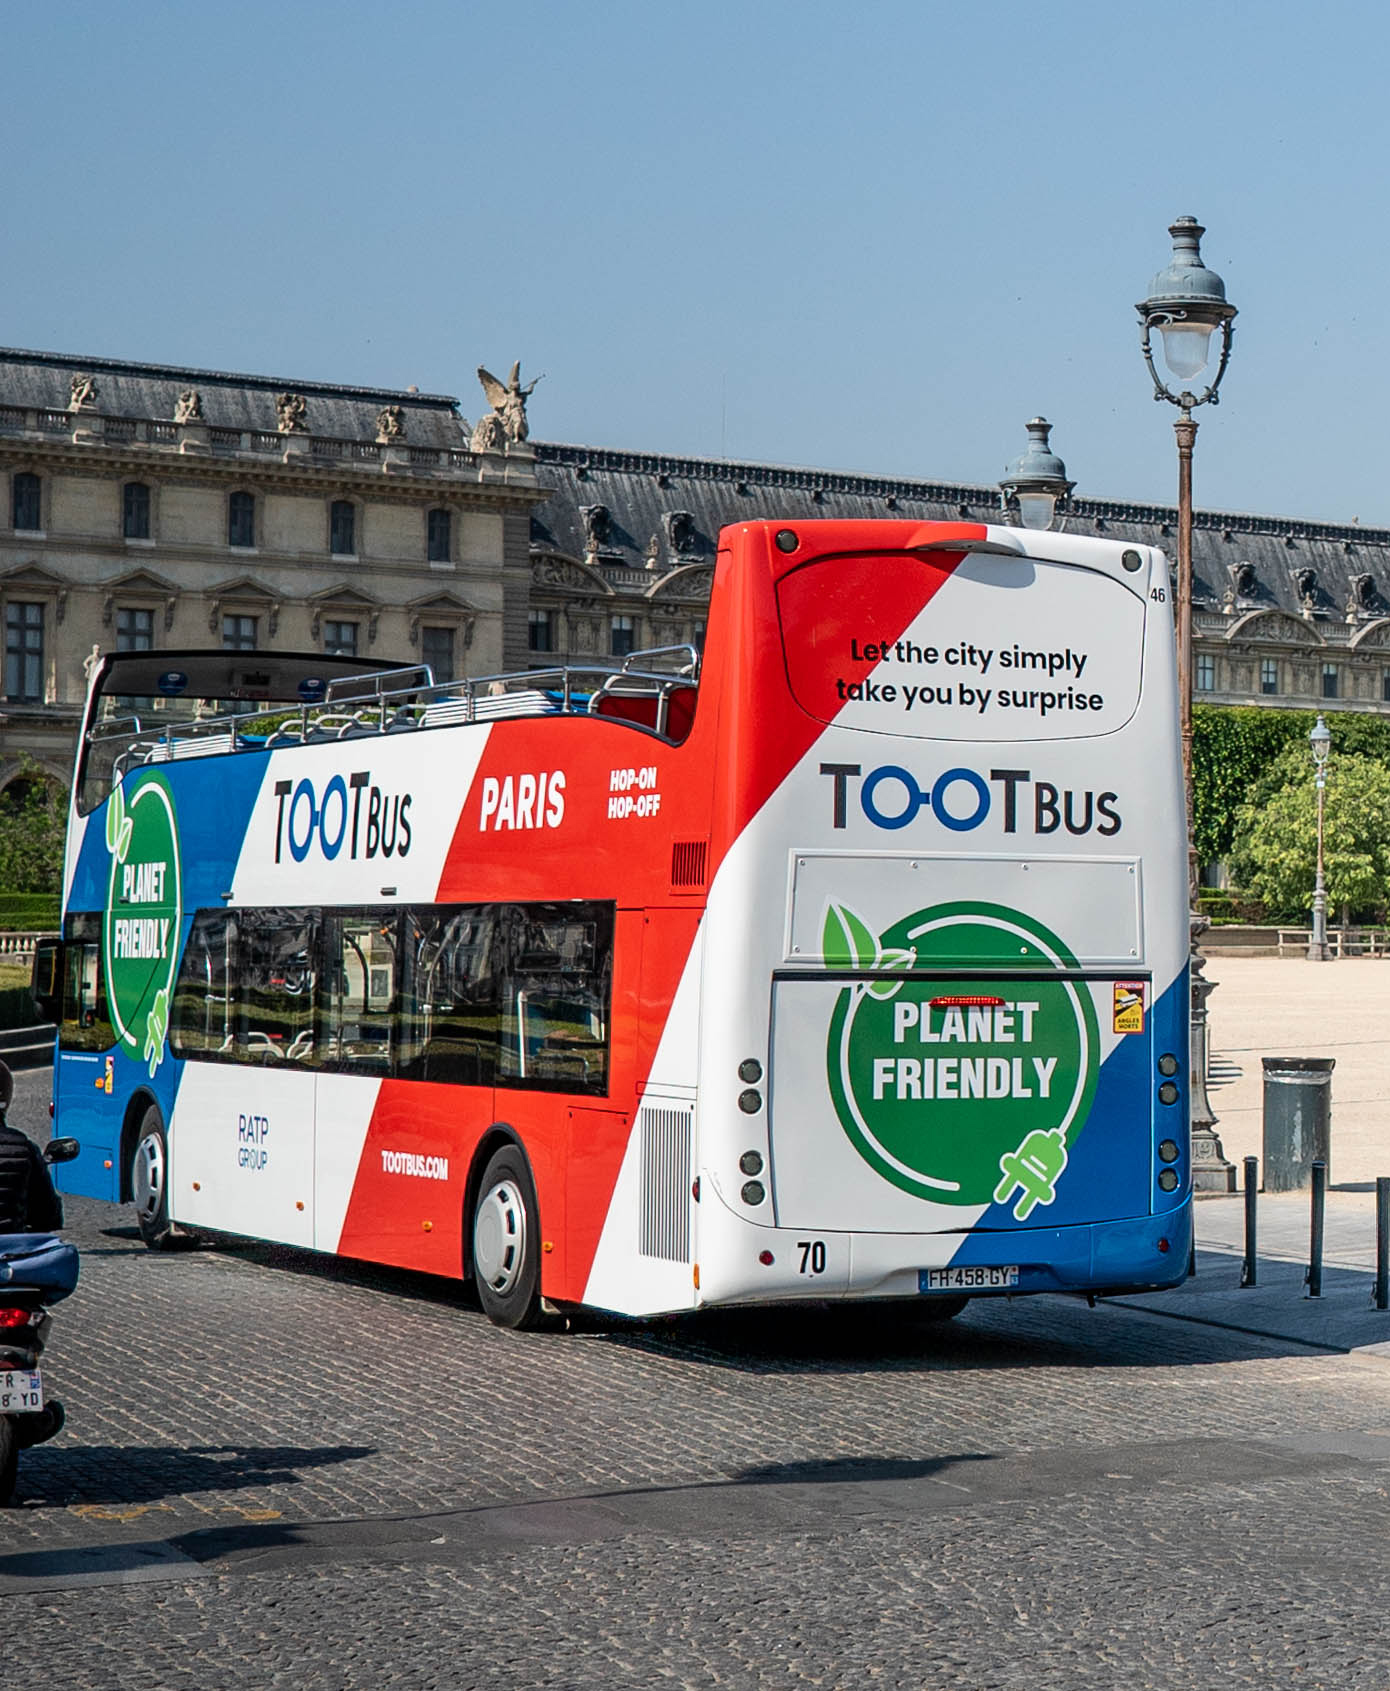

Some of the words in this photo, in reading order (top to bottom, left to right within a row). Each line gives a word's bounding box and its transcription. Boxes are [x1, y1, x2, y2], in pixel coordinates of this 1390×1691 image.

[1150, 587, 1167, 603] 46
[851, 638, 889, 662] Let
[895, 640, 939, 665] the
[944, 642, 993, 674] city
[999, 646, 1087, 678] simply
[836, 678, 896, 703] take
[902, 685, 952, 710] you
[958, 682, 992, 714] by
[997, 688, 1104, 716] surprise
[610, 767, 657, 792] HOP-ON
[480, 770, 566, 832] PARIS
[608, 794, 661, 820] HOP-OFF
[123, 862, 166, 903] PLANET
[114, 918, 169, 959] FRIENDLY
[893, 1001, 1040, 1043] PLANET
[873, 1057, 1058, 1100] FRIENDLY
[238, 1114, 269, 1144] RATP
[238, 1148, 267, 1170] GROUP
[381, 1150, 449, 1180] TOOTBUS.COM
[797, 1241, 826, 1274] 70
[929, 1268, 1010, 1287] FH-458-GY
